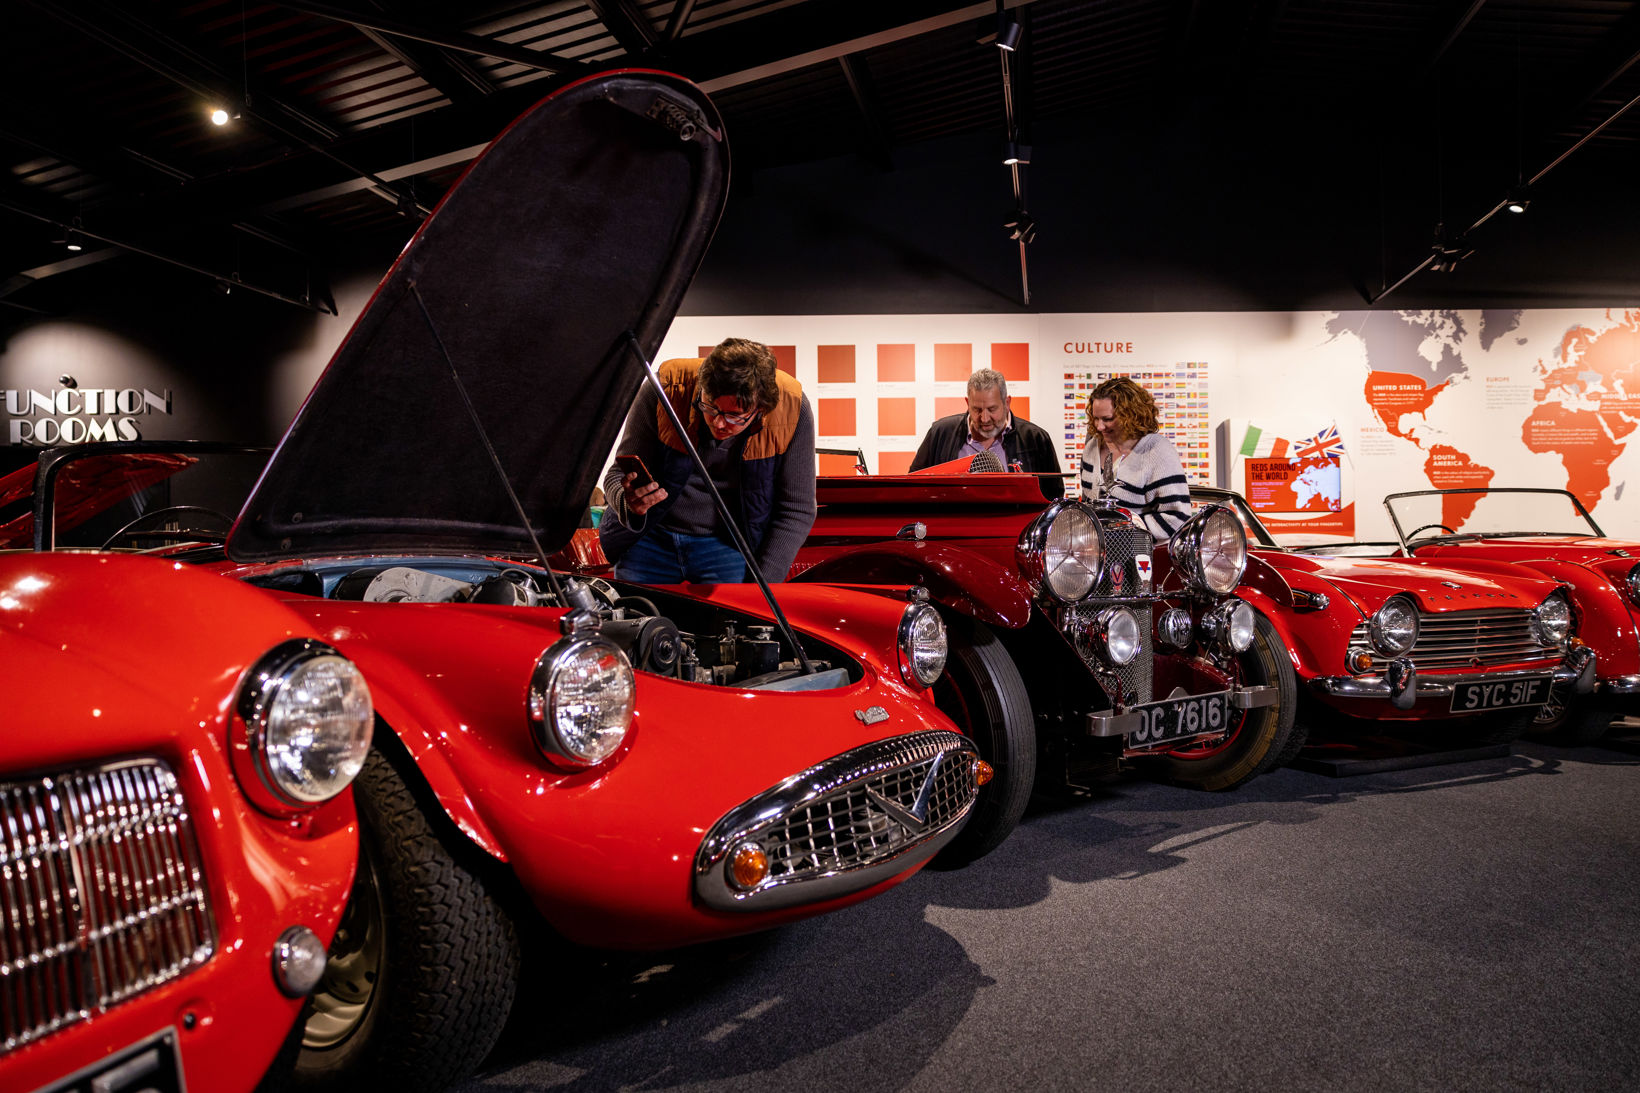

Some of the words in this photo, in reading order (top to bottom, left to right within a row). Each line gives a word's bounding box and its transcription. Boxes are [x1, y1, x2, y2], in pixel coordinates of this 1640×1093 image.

[1063, 342, 1134, 354] CULTURE
[9, 417, 139, 444] ROOMS
[1251, 463, 1269, 472] REDS
[1270, 463, 1296, 472] AROUND
[1251, 472, 1264, 480] THE
[1266, 472, 1289, 480] WORLD
[1465, 684, 1505, 709] SYC
[1510, 680, 1541, 704] 51F
[1173, 697, 1222, 734] 7616
